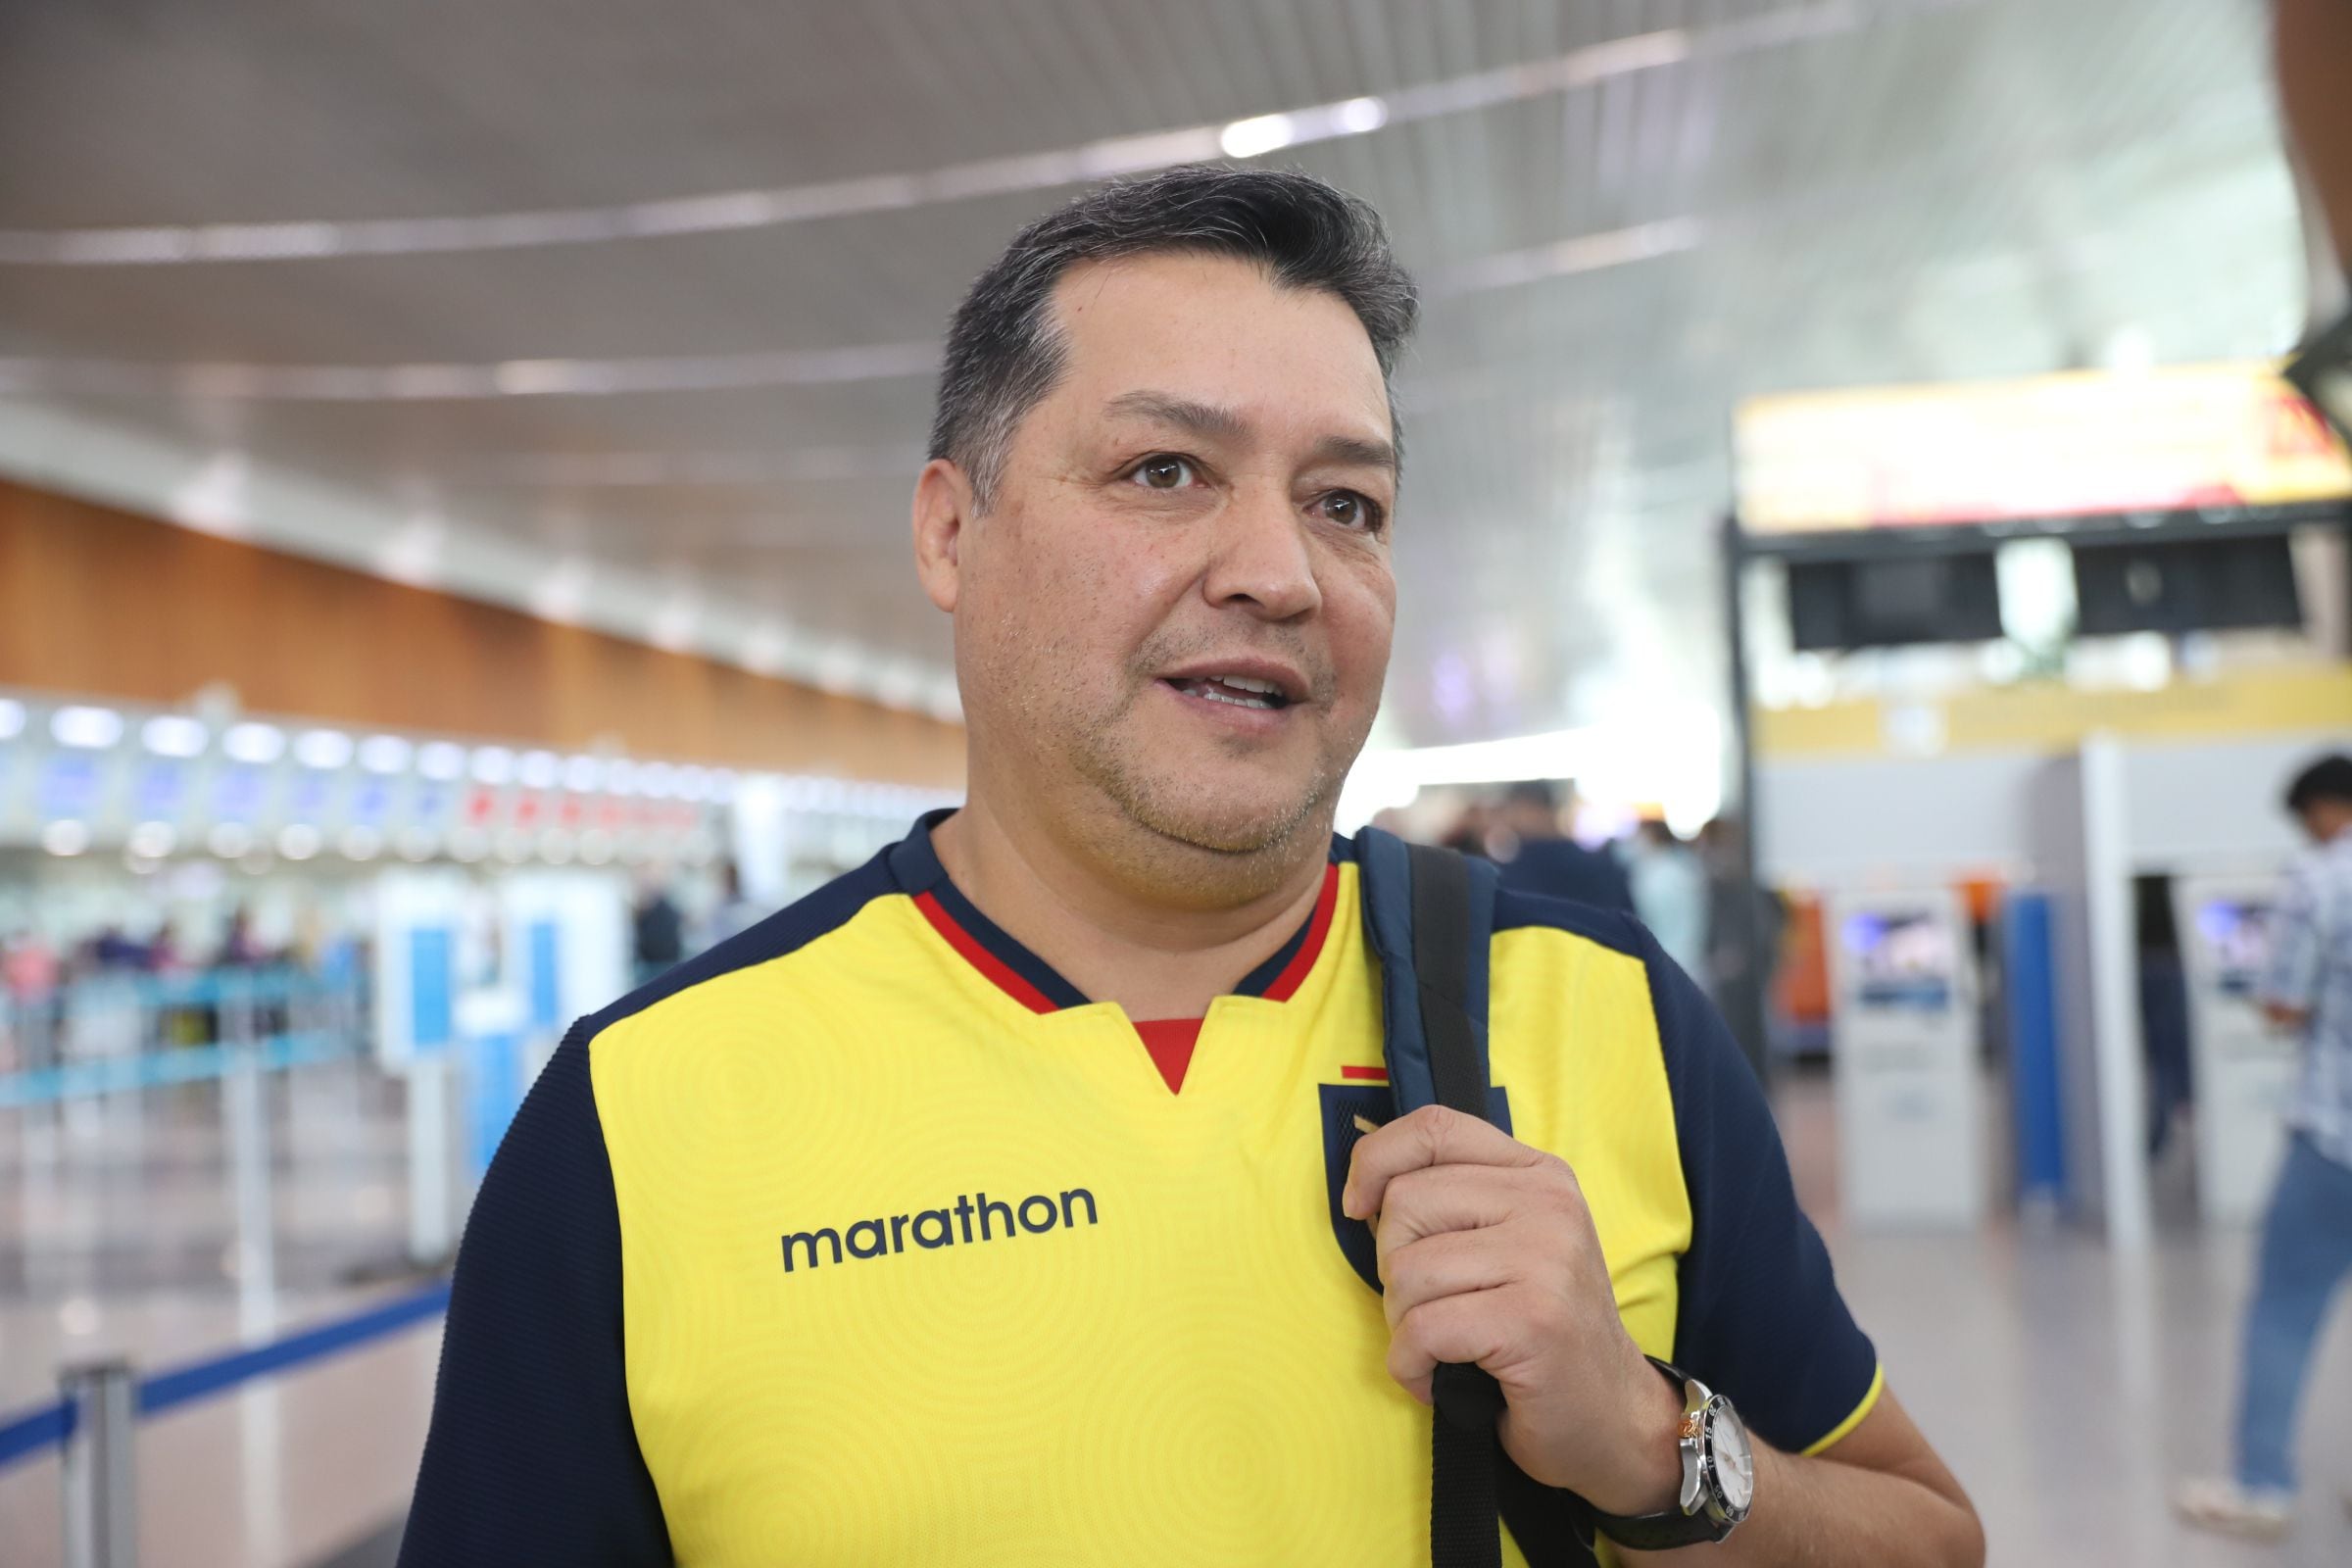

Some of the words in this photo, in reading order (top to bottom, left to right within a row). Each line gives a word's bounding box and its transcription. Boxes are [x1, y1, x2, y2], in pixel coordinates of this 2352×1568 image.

[781, 1188, 1099, 1273] marathon
[1705, 1426, 1713, 1440] 15
[1706, 1455, 1715, 1470] 10
